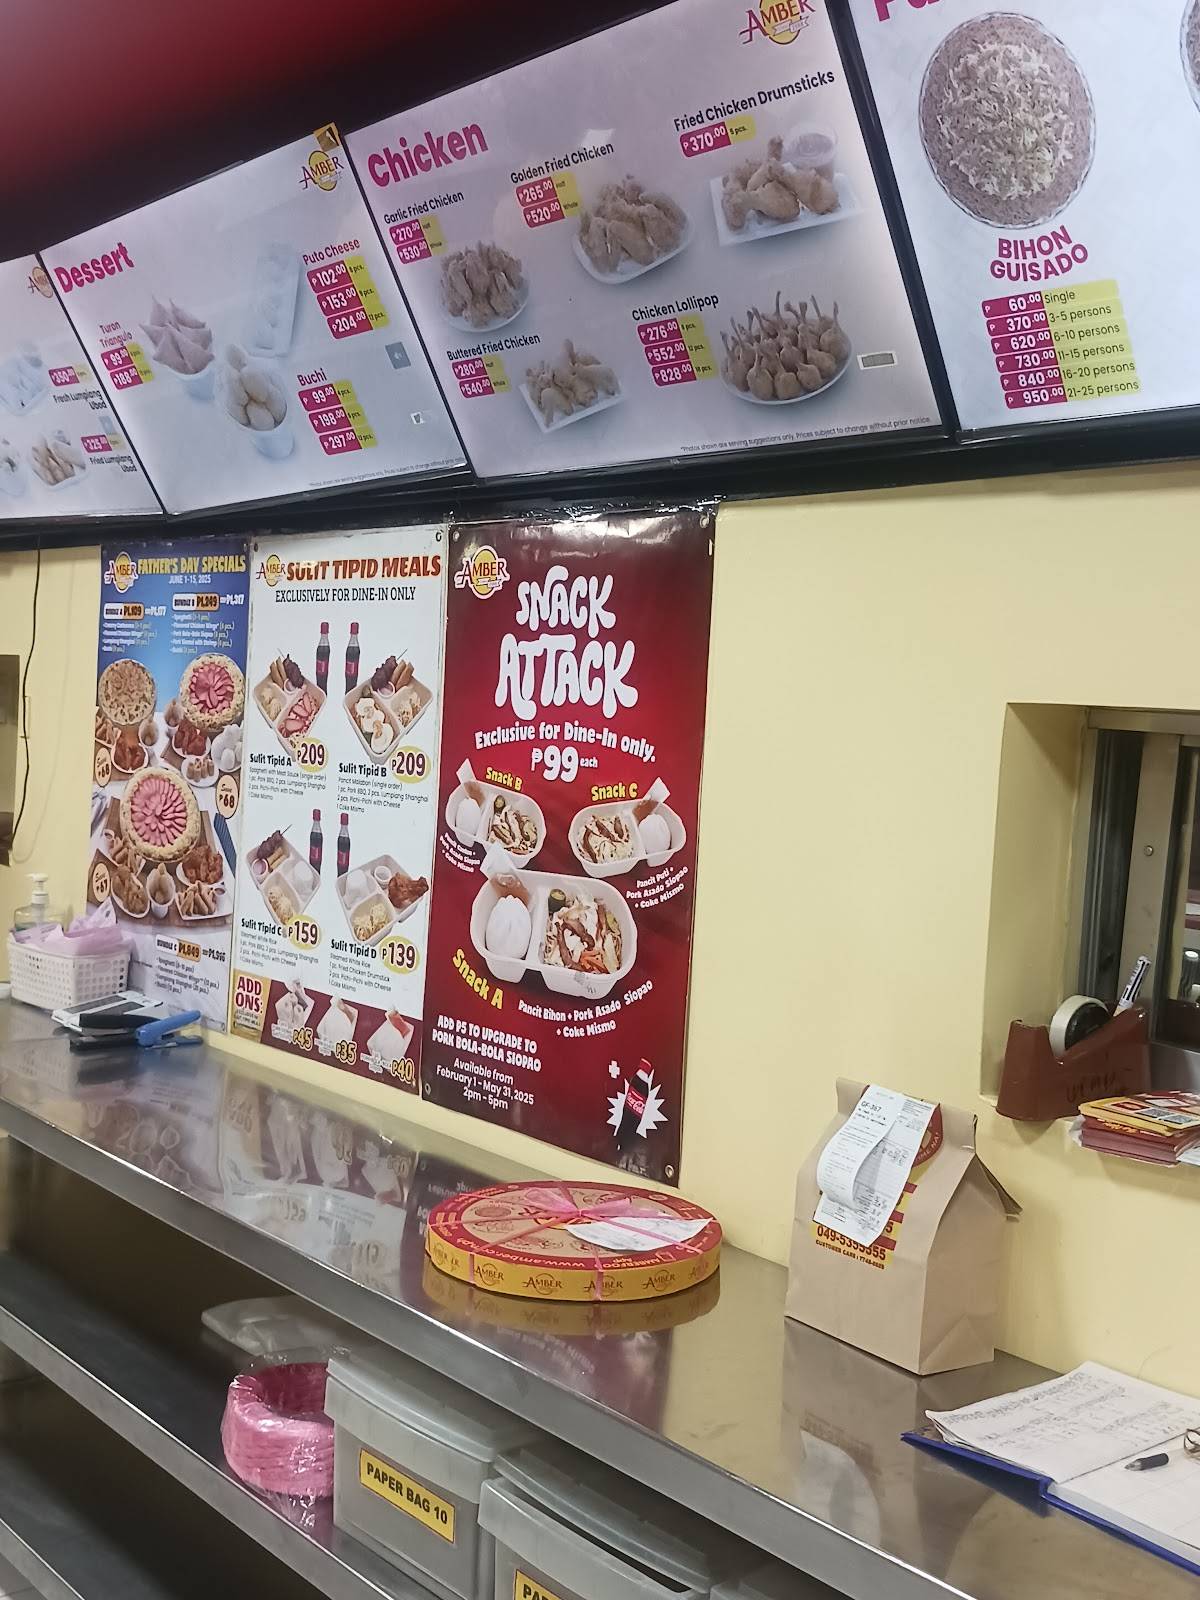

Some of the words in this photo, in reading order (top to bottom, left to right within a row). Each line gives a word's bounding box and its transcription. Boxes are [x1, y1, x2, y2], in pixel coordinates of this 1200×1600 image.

[674, 110, 704, 132] Fried
[705, 96, 757, 120] Chicken
[757, 71, 835, 105] Drumsticks
[368, 124, 488, 187] Chicken
[510, 165, 545, 184] Golden
[545, 155, 571, 173] Fried
[571, 143, 614, 164] Chicken
[299, 156, 344, 190] AMBER
[384, 208, 408, 224] Garlic
[408, 201, 429, 217] Fried
[428, 192, 464, 210] Chicken
[302, 250, 324, 265] Puto
[324, 239, 360, 258] Cheese
[998, 225, 1073, 260] BIHON
[54, 242, 134, 293] Dessert
[990, 244, 1088, 282] GUISADO
[632, 302, 676, 321] Chicken
[676, 293, 719, 313] Lollipop
[1044, 290, 1075, 304] Single
[1049, 311, 1067, 322] 3-5
[1070, 305, 1112, 322] persons
[99, 322, 121, 334] Turon
[99, 331, 132, 348] Triangulo
[1054, 330, 1076, 341] 6-10
[1078, 324, 1121, 341] persons
[446, 344, 482, 361] Buttered
[482, 341, 504, 354] Fried
[504, 335, 541, 349] Chicken
[1058, 348, 1081, 361] 11-15
[1083, 343, 1125, 359] persons
[297, 368, 327, 387] Buchi
[1062, 366, 1091, 380] 16-20
[1093, 362, 1135, 378] persons
[1067, 385, 1095, 398] 21-25
[1096, 381, 1139, 396] persons
[137, 557, 178, 574] FATHER'S
[180, 557, 200, 573] DAY
[201, 555, 246, 573] SPECIALS
[256, 561, 286, 580] AMBER
[287, 560, 330, 581] SULIT
[332, 559, 379, 580] TIPID
[381, 555, 441, 578] MEALS
[455, 559, 508, 588] AMBER
[275, 588, 330, 603] EXCLUSIVELY
[332, 588, 350, 601] FOR
[351, 587, 388, 601] DINE-IN
[390, 586, 416, 601] ONLY
[516, 565, 616, 638] SNACK
[495, 633, 638, 720] ATTACK
[474, 721, 535, 750] Exclusive
[539, 722, 560, 740] for
[564, 720, 617, 749] Dine-In
[620, 734, 656, 762] only.
[249, 753, 267, 764] Sulit
[267, 754, 285, 767] Tipid
[285, 757, 292, 767] A
[339, 762, 357, 775] Sulit
[359, 764, 379, 777] Tipid
[380, 767, 387, 777] B
[580, 756, 598, 768] each
[485, 767, 514, 787] Snack
[514, 777, 523, 791] B
[591, 784, 625, 801] Snack
[628, 783, 638, 798] C
[626, 890, 642, 899] Pork
[643, 885, 664, 898] Asado
[665, 866, 688, 888] Siopao
[636, 876, 656, 889] Pancit
[656, 867, 670, 882] Puti
[640, 898, 659, 909] Coke
[660, 883, 684, 903] Mismo
[241, 918, 257, 930] Sulit
[257, 922, 275, 936] Tipid
[276, 927, 283, 937] C
[330, 939, 349, 951] Sulit
[349, 941, 370, 958] Tipid
[371, 949, 377, 959] D
[237, 976, 262, 996] ADD
[452, 948, 490, 1000] Snack
[490, 988, 504, 1010] A
[235, 992, 263, 1014] ONS:
[518, 999, 542, 1018] Pancit
[543, 1007, 566, 1021] Bihon
[574, 1008, 594, 1021] Pork
[595, 1000, 621, 1018] Asado
[624, 980, 653, 1006] Siopao
[437, 1015, 454, 1031] ADD
[469, 1022, 481, 1036] TO
[481, 1028, 522, 1049] UPGRADE
[523, 1039, 538, 1054] TO
[563, 1026, 585, 1038] Coke
[586, 1020, 617, 1036] Mismo
[432, 1029, 454, 1047] PORK
[455, 1035, 505, 1062] BOLA-BOLA
[506, 1048, 542, 1072] SIOPAO
[436, 1065, 473, 1087] February
[482, 1081, 501, 1098] May
[453, 1057, 492, 1078] Available
[492, 1069, 514, 1086] from
[463, 1086, 481, 1103] 2pm
[487, 1095, 508, 1110] 5pm
[475, 1265, 504, 1281] AMBER
[521, 1277, 563, 1290] AMBER
[641, 1274, 682, 1290] AMBER
[367, 1462, 403, 1496] PAPER
[406, 1487, 430, 1513] BAG
[434, 1506, 448, 1525] 10
